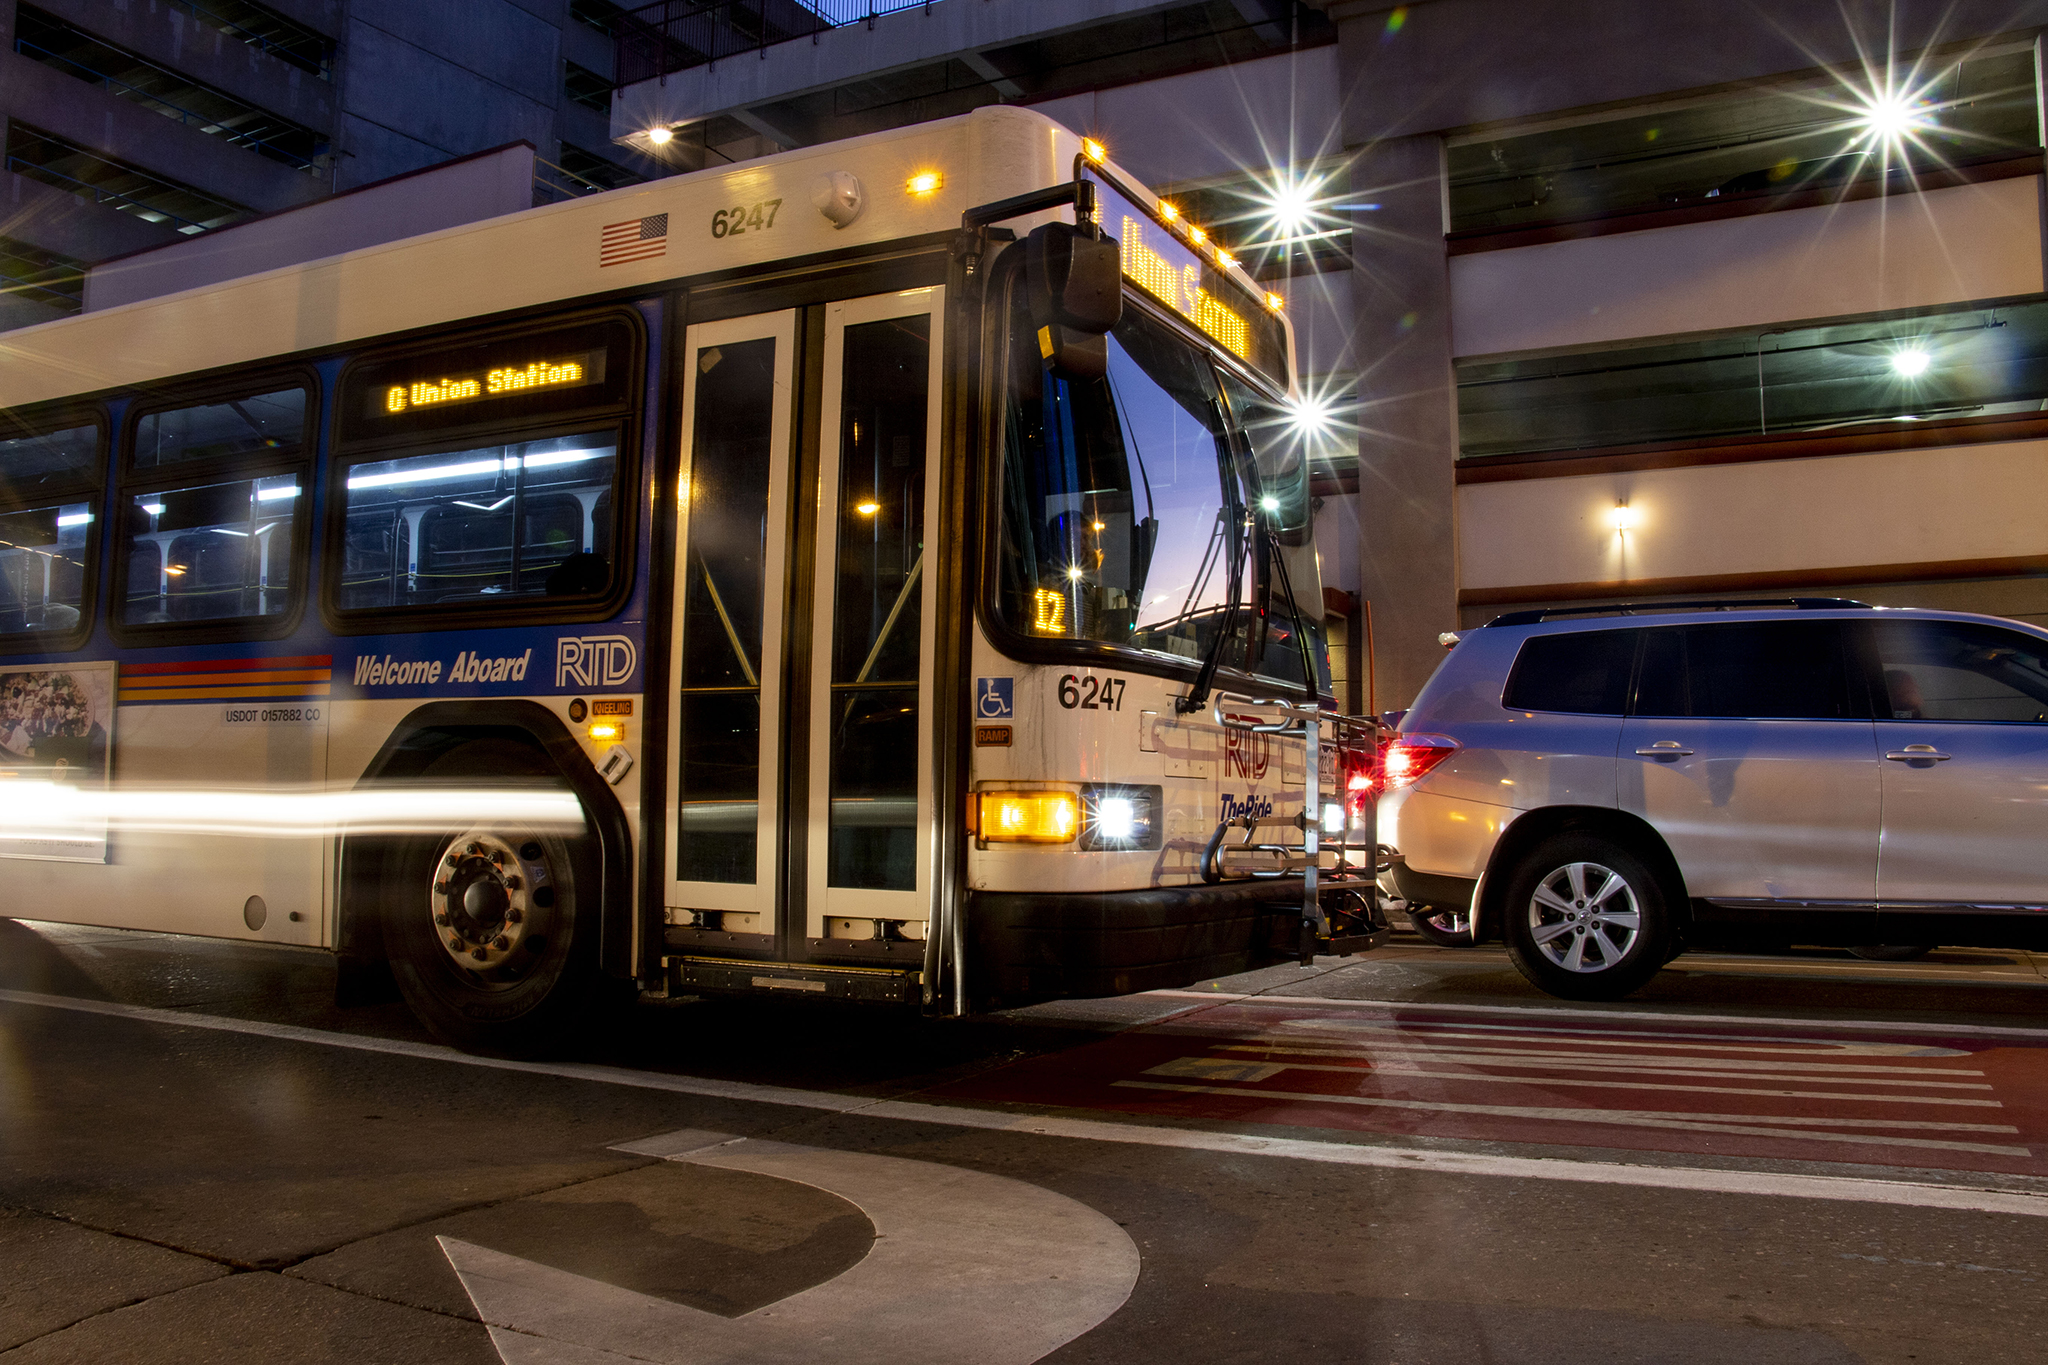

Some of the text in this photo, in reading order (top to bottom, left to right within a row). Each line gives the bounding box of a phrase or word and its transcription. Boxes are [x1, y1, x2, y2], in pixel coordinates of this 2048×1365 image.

[711, 198, 782, 239] 6247
[412, 378, 481, 405] Union
[487, 361, 583, 394] Station
[1035, 588, 1066, 633] 12
[353, 648, 532, 686] Welcome Aboard
[555, 634, 638, 687] RTD
[593, 701, 631, 714] KNEELING
[1058, 674, 1127, 712] 6247
[226, 708, 320, 722] USDOT 0157882 CO
[978, 729, 1009, 743] RAMP
[1224, 713, 1270, 780] RTD
[1220, 793, 1272, 822] TheRide
